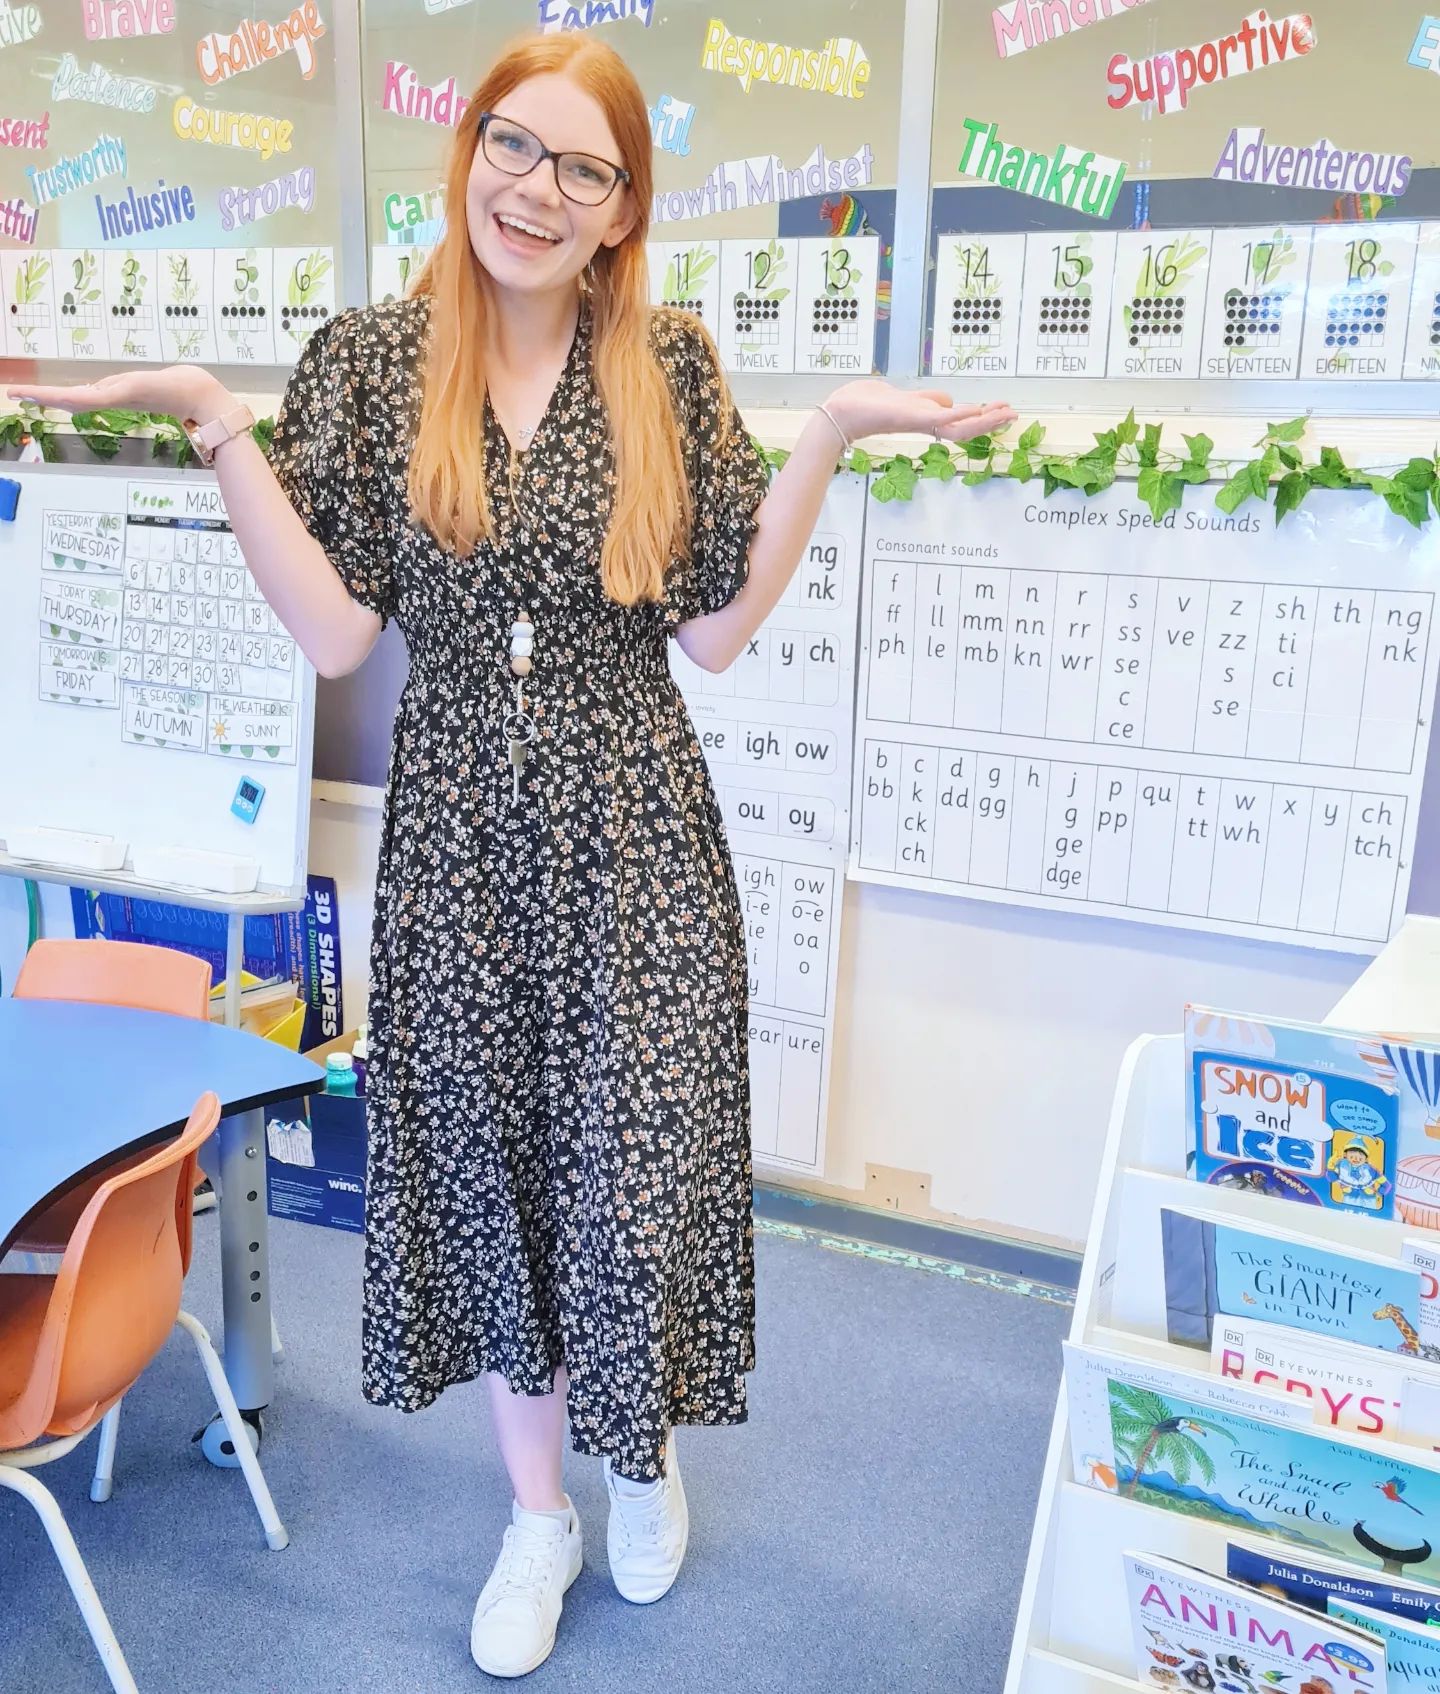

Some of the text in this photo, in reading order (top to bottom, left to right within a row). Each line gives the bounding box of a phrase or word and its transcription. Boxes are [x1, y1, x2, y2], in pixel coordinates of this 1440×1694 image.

[82, 0, 175, 40] Brave
[992, 0, 1147, 59] Mind
[197, 0, 326, 85] Challenge
[703, 17, 871, 99] Responsible
[1107, 8, 1314, 114] Supportive
[52, 53, 157, 113] Patience
[173, 97, 294, 160] Courage
[26, 134, 128, 205] Trustworthy
[959, 118, 1128, 220] Thankful
[1212, 128, 1413, 196] Adventerous
[745, 144, 875, 206] Mindset
[95, 179, 195, 241] Inclusive
[218, 167, 316, 231] Strong
[72, 259, 84, 290] 2
[235, 258, 249, 291] 5
[295, 258, 311, 291] 6
[673, 252, 689, 290] 11
[745, 251, 771, 289] 12
[821, 249, 850, 290] 13
[963, 247, 995, 288] 14
[1052, 245, 1084, 287] 15
[1143, 245, 1177, 287] 16
[1242, 243, 1274, 285] 17
[1345, 239, 1377, 286] 18
[123, 258, 137, 292] 3
[178, 258, 191, 294] 4
[24, 343, 38, 354] ONE
[74, 343, 95, 356] TWO
[122, 345, 148, 358] THREE
[178, 346, 201, 358] FOUR
[237, 346, 254, 359] FIVE
[734, 353, 779, 368] TWELVE
[807, 354, 861, 368] THIRTEEN
[941, 356, 1007, 371] FOURTEEN
[1036, 356, 1086, 371] FIFTEEN
[1124, 358, 1182, 373] SIXTEEN
[1207, 358, 1292, 373] SEVENTEEN
[1316, 358, 1387, 374] EIGHTEEN
[46, 513, 93, 527] YESTERDAY
[1024, 505, 1261, 533] Complex Speed Sounds
[50, 530, 120, 561] WEDNESDAY
[876, 538, 999, 558] Consonant sounds
[810, 546, 837, 571] ng
[59, 584, 85, 600] TODAY
[226, 573, 238, 589] 10
[808, 575, 835, 600] nk
[43, 597, 110, 631] THURSDAY
[201, 603, 212, 619] 16
[1276, 596, 1305, 620] sh
[1334, 599, 1360, 623] th
[964, 615, 1003, 632] mm
[1016, 619, 1044, 635] nn
[1388, 610, 1421, 635] ng
[125, 625, 236, 655] 20 24
[810, 638, 834, 662] ch
[879, 633, 904, 658] ph
[928, 636, 945, 658] le
[1168, 630, 1194, 646] ve
[1384, 638, 1417, 662] nk
[48, 646, 95, 661] TOMORROW
[965, 641, 998, 662] mb
[1015, 643, 1041, 667] kn
[1062, 655, 1093, 670] wr
[149, 659, 212, 683] 28 30
[1115, 658, 1139, 674] se
[56, 671, 94, 691] FRIDAY
[131, 687, 185, 703] THE SEASON
[214, 698, 276, 716] THE WEATHER
[135, 710, 192, 737] AUTUMN
[245, 725, 280, 738] SUNNY
[703, 732, 725, 748] ee
[747, 731, 780, 760] igh
[796, 742, 828, 760] ow
[1143, 786, 1171, 806] qu
[739, 803, 764, 820] ou
[789, 809, 815, 833] oy
[1362, 802, 1392, 825] ch
[1224, 821, 1260, 843] wh
[1056, 838, 1082, 857] ge
[1355, 835, 1392, 858] tch
[745, 865, 775, 889] igh
[795, 879, 824, 894] ow
[1047, 862, 1081, 889] dge
[748, 921, 765, 940] ie
[794, 933, 818, 949] oa
[308, 929, 321, 1010] Dimensional)
[315, 891, 337, 1036] 3D SHAPES
[789, 1036, 820, 1053] ure
[1214, 1066, 1310, 1109] SNOW
[1255, 1104, 1291, 1133] and
[328, 1178, 362, 1193] winc.
[1416, 1256, 1433, 1269] DK
[1231, 1251, 1383, 1300] The Smartest
[1254, 1269, 1363, 1315] GIANT
[1265, 1302, 1350, 1330] in Town
[1226, 1332, 1242, 1344] DK
[1086, 1360, 1111, 1374] Julia
[1257, 1352, 1272, 1365] DK
[1279, 1360, 1374, 1388] EYEWITNESS
[1208, 1389, 1256, 1410] Rebecca
[1189, 1406, 1215, 1420] Julia
[1230, 1450, 1351, 1496] The Snail
[1258, 1477, 1320, 1499] and the
[1238, 1484, 1340, 1526] Whale
[1137, 1567, 1250, 1612] DK EYEWITNESS
[1268, 1565, 1298, 1582] Julia
[1302, 1574, 1374, 1598] Donaldson
[1392, 1592, 1431, 1611] Emily
[1353, 1616, 1382, 1635] Julia
